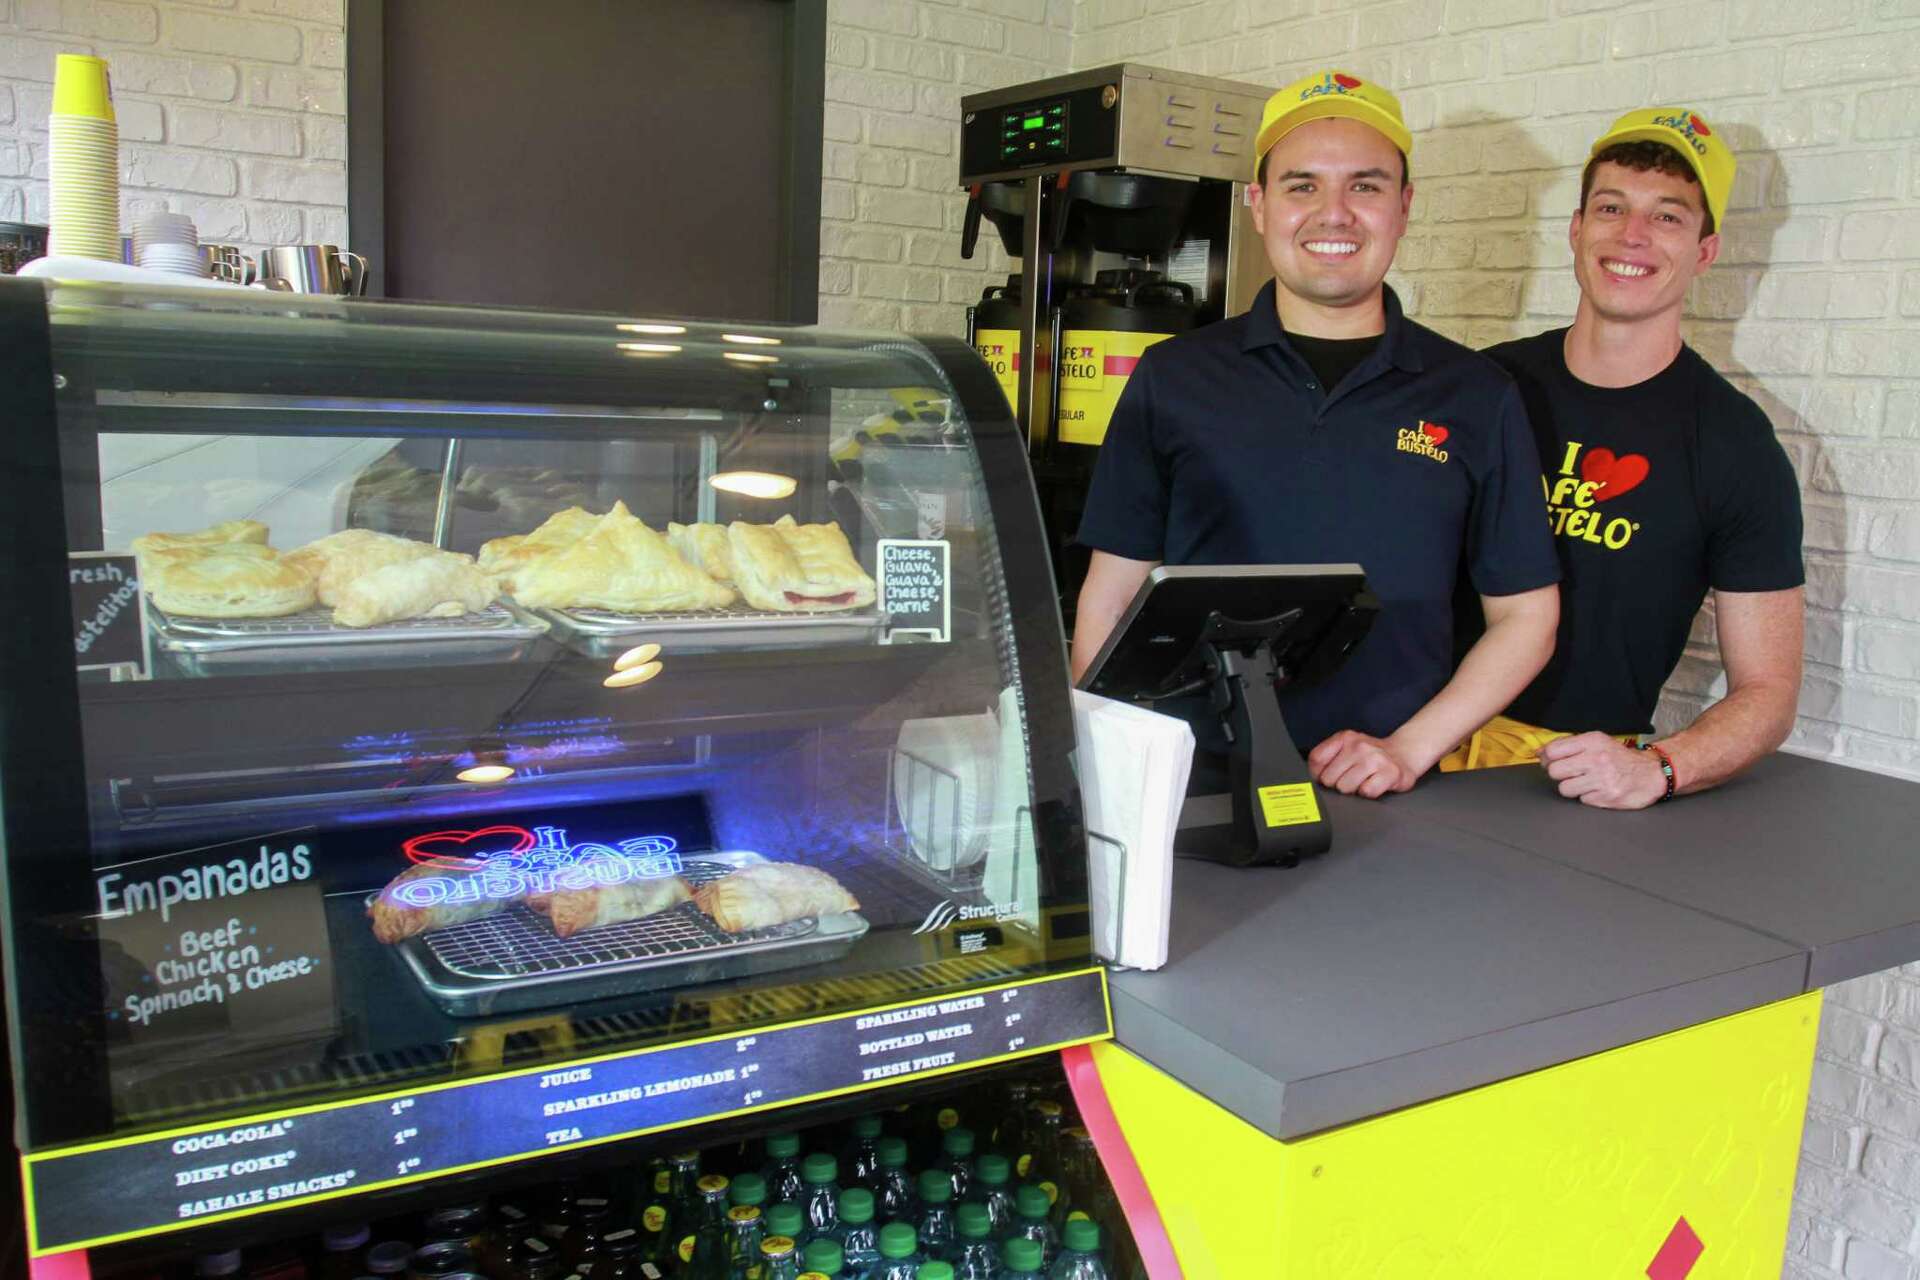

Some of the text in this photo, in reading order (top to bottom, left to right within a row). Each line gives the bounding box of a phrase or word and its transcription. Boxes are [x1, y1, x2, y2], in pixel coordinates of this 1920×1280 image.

[1397, 439, 1449, 463] BUSTELO
[1559, 441, 1583, 476] I
[69, 562, 122, 584] resh
[886, 575, 931, 587] Guava
[74, 577, 138, 653] astelitos
[97, 844, 311, 922] Empanadas
[180, 918, 242, 956] Beef
[156, 945, 260, 985] Chicken
[125, 956, 312, 1025] Spinach & Cheese
[856, 1005, 938, 1030] SPARKLING
[938, 997, 986, 1015] WATER
[859, 1032, 924, 1056] BOTTLED
[926, 1023, 973, 1043] WATER
[540, 1068, 592, 1089] JUICE
[862, 1060, 911, 1081] FRESH
[912, 1052, 956, 1071] FRUIT
[544, 1087, 642, 1117] SPARKLING
[645, 1068, 736, 1097] LEMONADE
[546, 1127, 583, 1145] TEA
[176, 1164, 229, 1186] DIET
[179, 1188, 265, 1218] SAHALE
